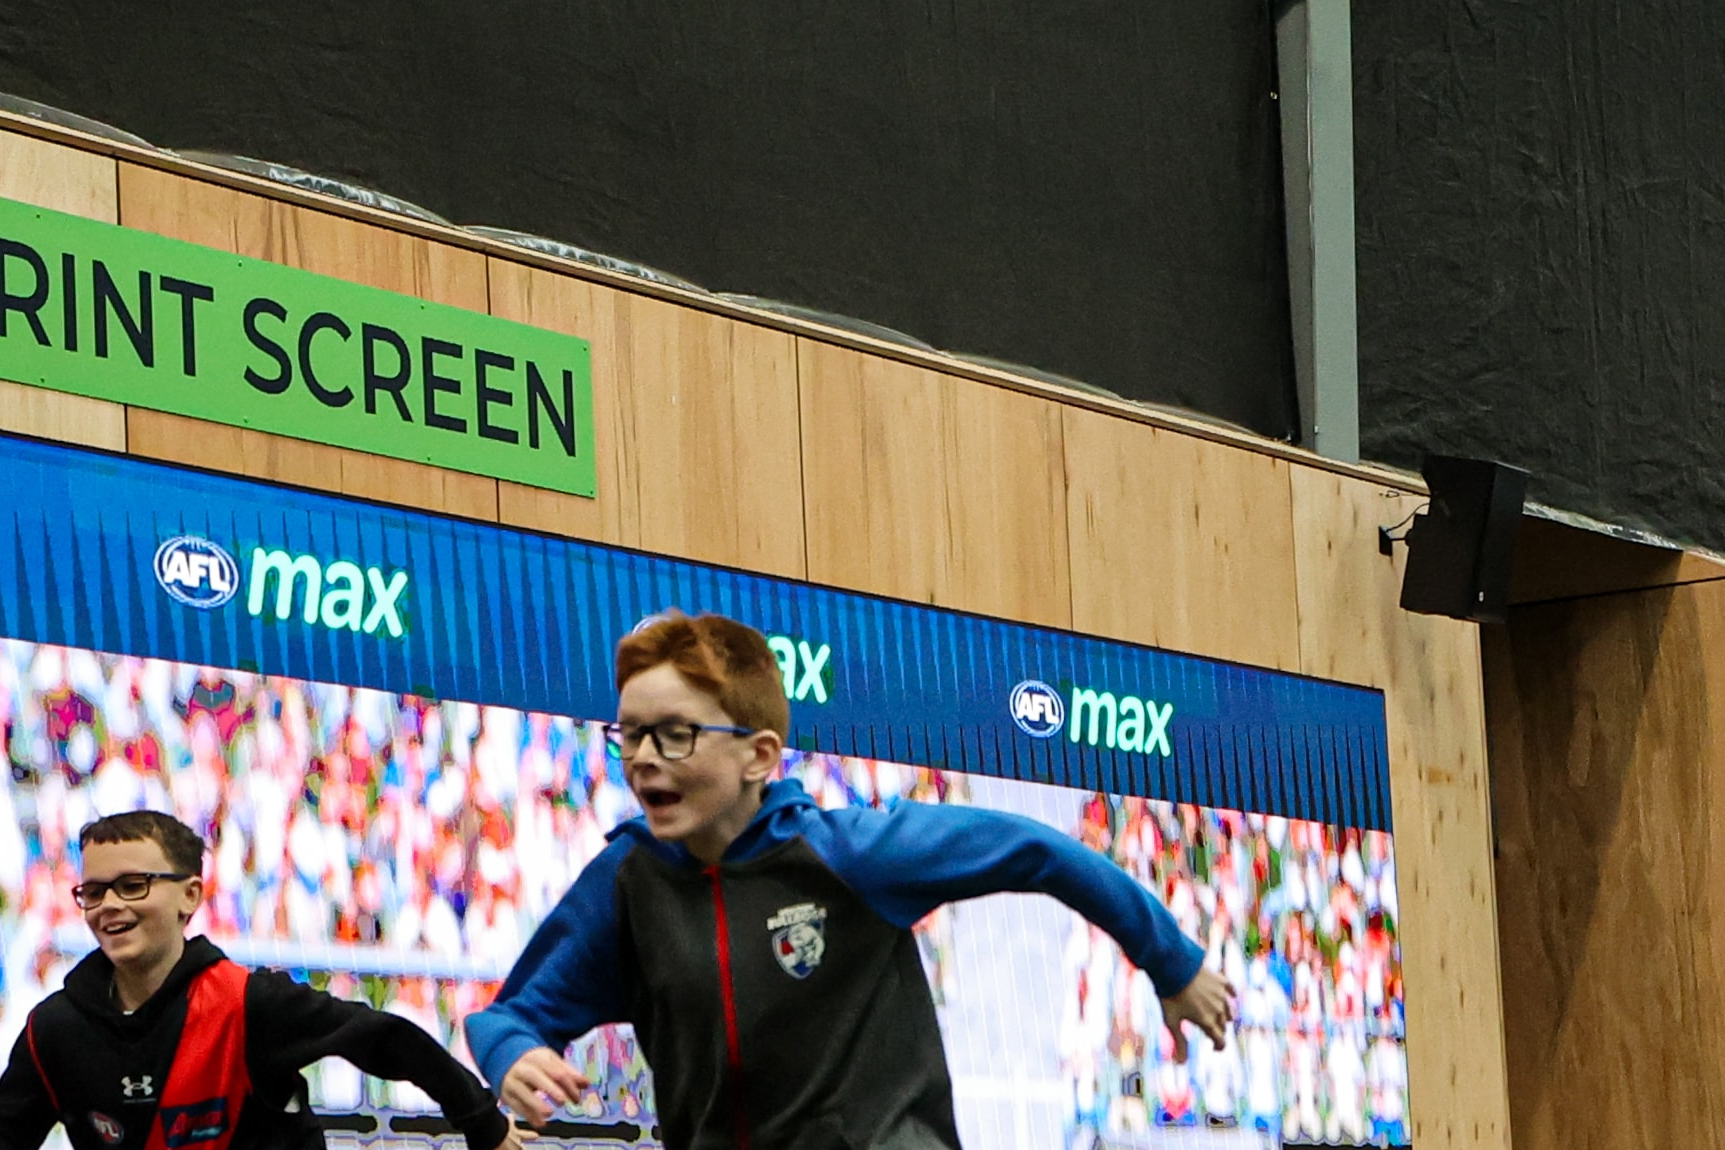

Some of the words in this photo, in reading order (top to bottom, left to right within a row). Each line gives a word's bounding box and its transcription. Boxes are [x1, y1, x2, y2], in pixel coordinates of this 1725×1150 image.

[242, 296, 577, 458] SCREEN
[164, 549, 232, 592] AFL
[247, 546, 408, 638] max
[767, 635, 831, 704] ax
[1016, 691, 1060, 725] AFL
[1069, 686, 1174, 758] max
